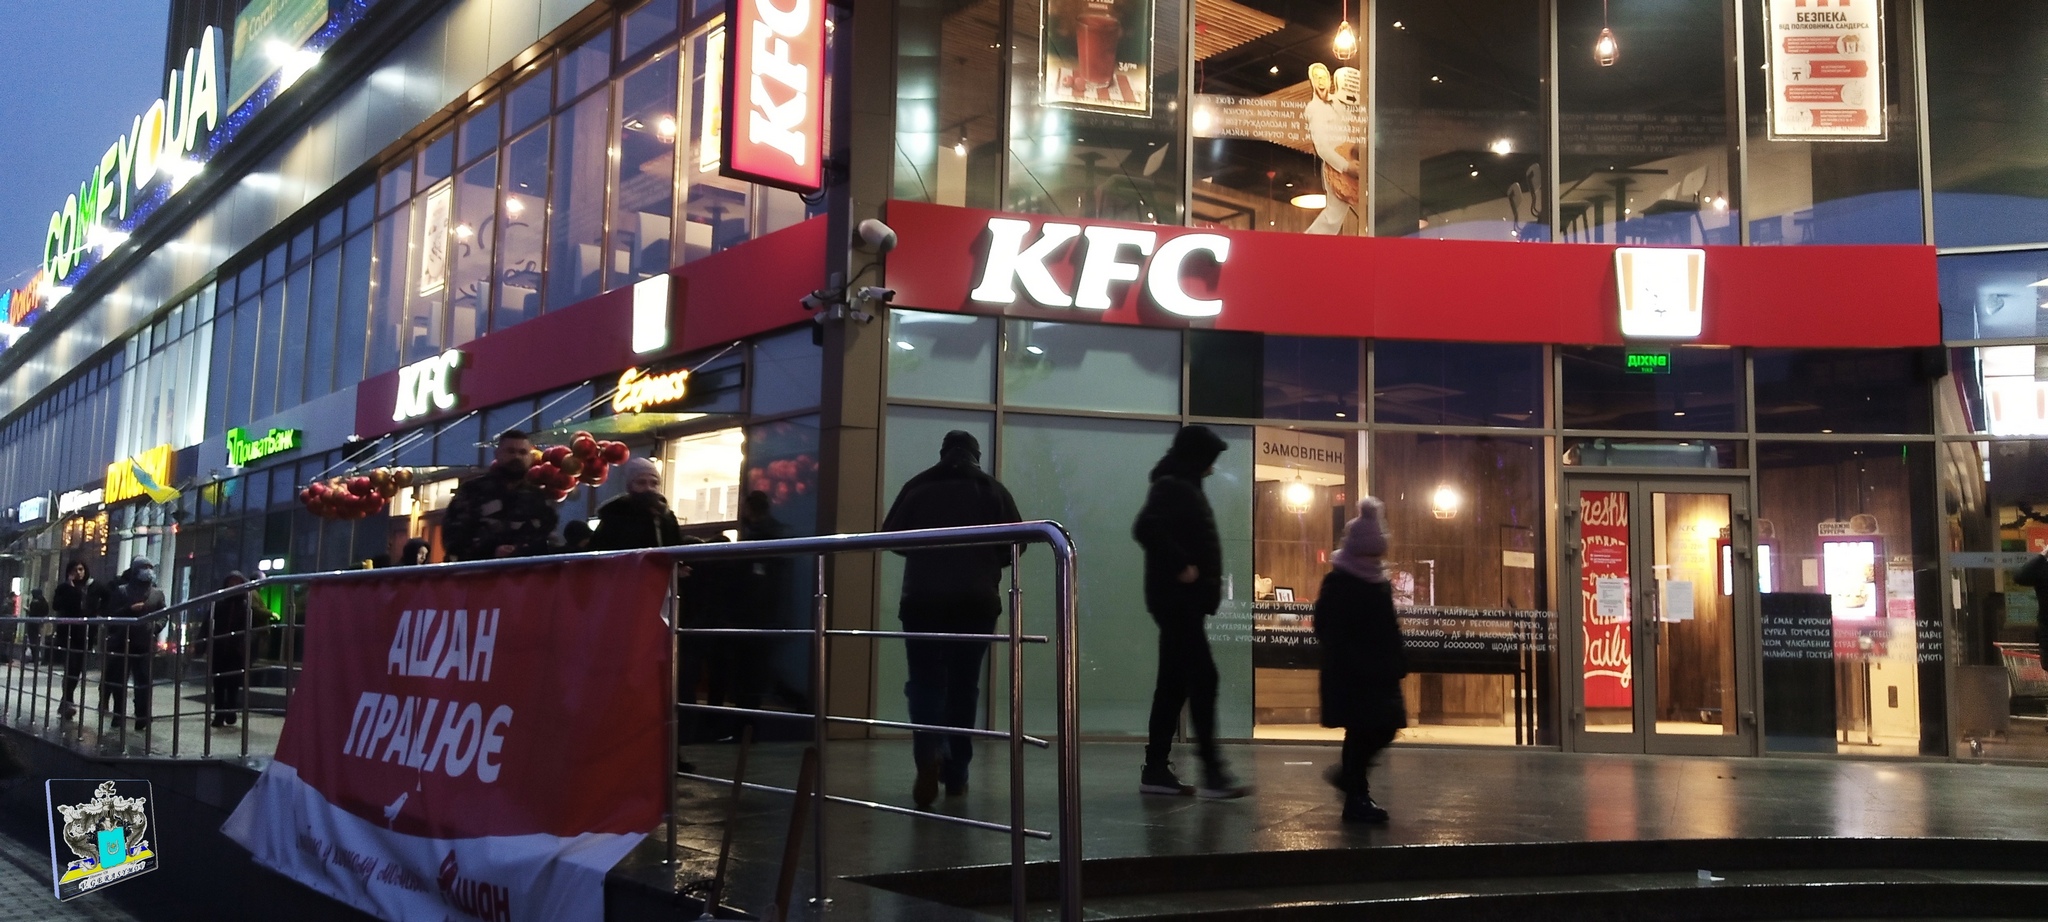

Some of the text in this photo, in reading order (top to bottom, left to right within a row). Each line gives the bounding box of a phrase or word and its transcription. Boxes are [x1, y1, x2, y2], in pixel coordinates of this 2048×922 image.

[1797, 12, 1847, 22] БЕЗПЕКА
[1791, 22, 1834, 30] ПОЛКОВНИКА
[970, 217, 1231, 318] KFC
[392, 349, 459, 421] KFC
[1284, 603, 1315, 611] РЕСТОРА
[1482, 609, 1506, 618] ЯКІСТЬ
[1773, 617, 1793, 625] СМАК
[1798, 617, 1831, 625] КУРОЧКИ
[1763, 628, 1787, 636] КУРКА
[387, 608, 500, 682] АШАН
[1785, 639, 1830, 648] УЛЮБЛЕНИХ
[343, 691, 514, 784] ПРАЦЮЄ
